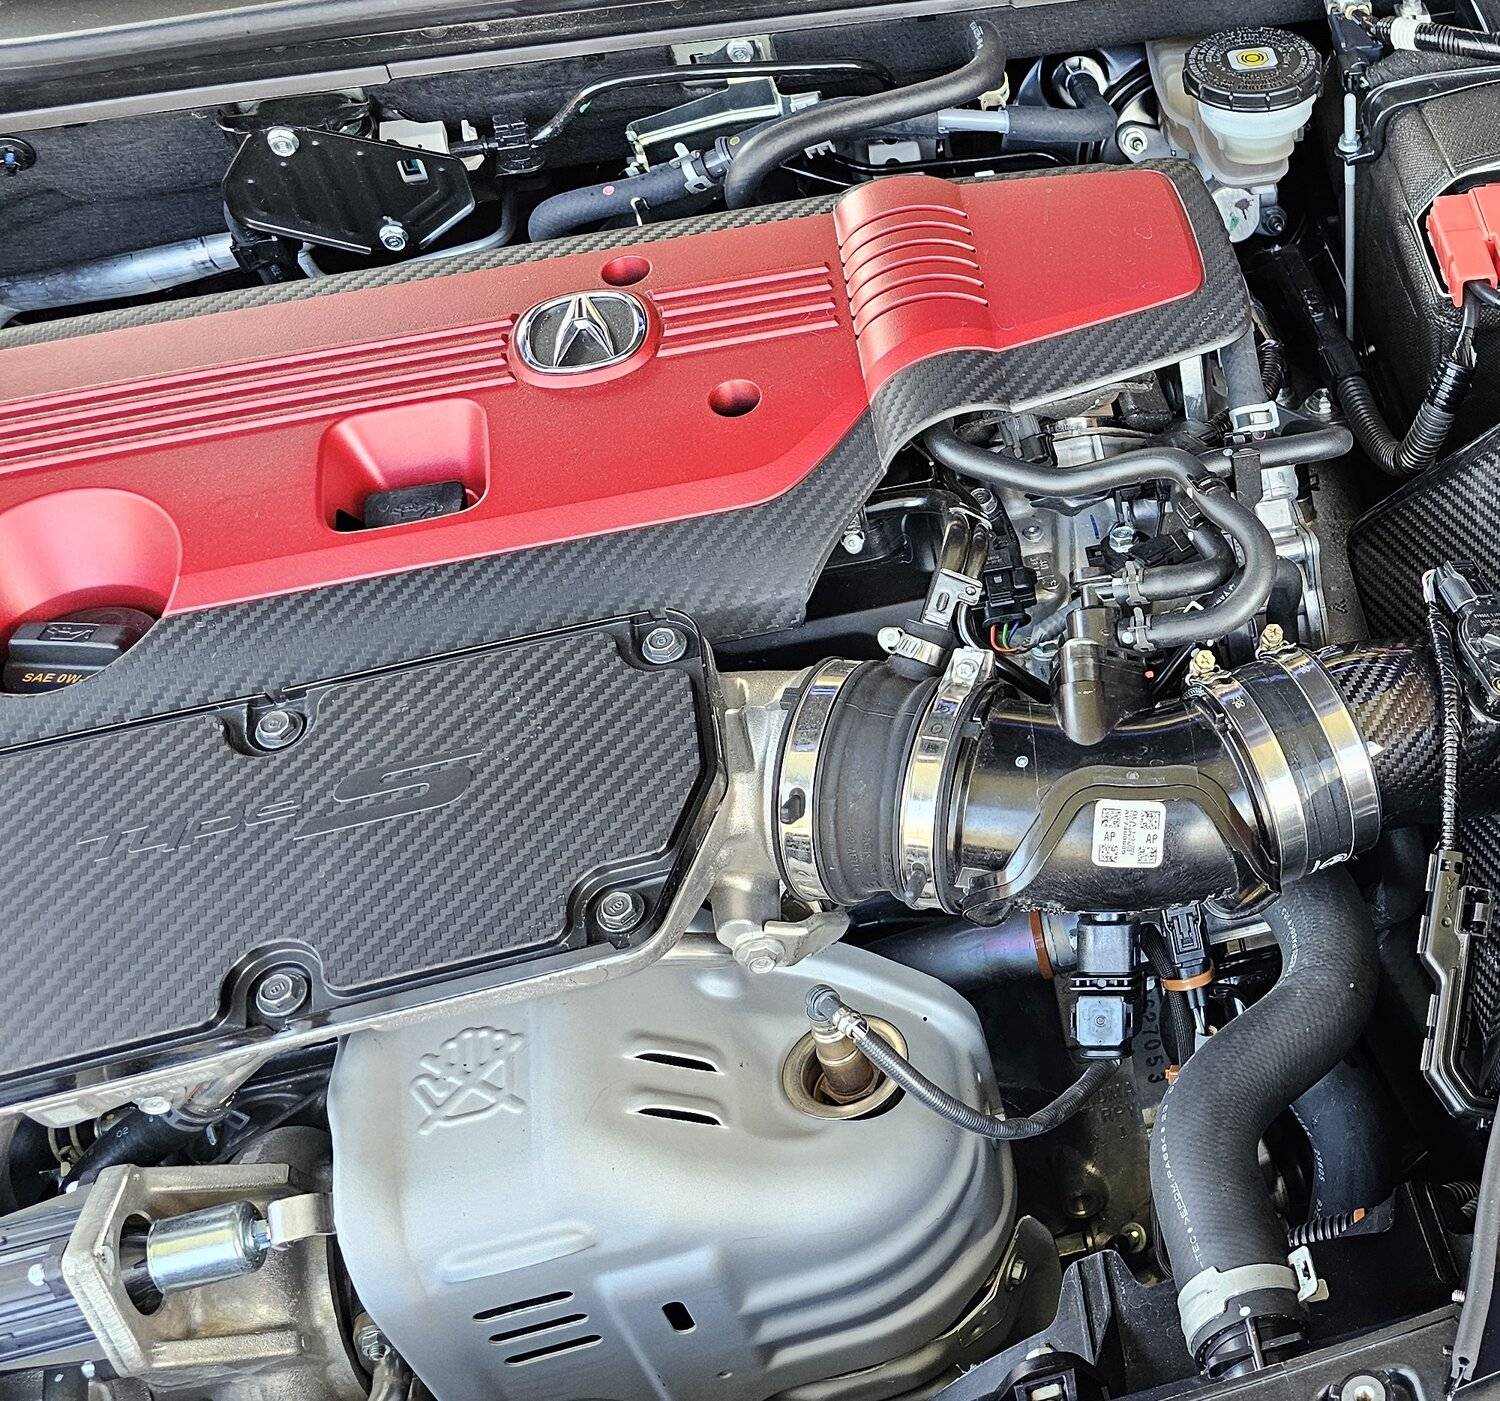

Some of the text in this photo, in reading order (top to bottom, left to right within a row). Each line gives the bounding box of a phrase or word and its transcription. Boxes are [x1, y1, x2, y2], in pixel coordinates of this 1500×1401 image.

[22, 673, 55, 683] SAE
[1103, 831, 1116, 842] AP
[1145, 833, 1159, 844] AP
